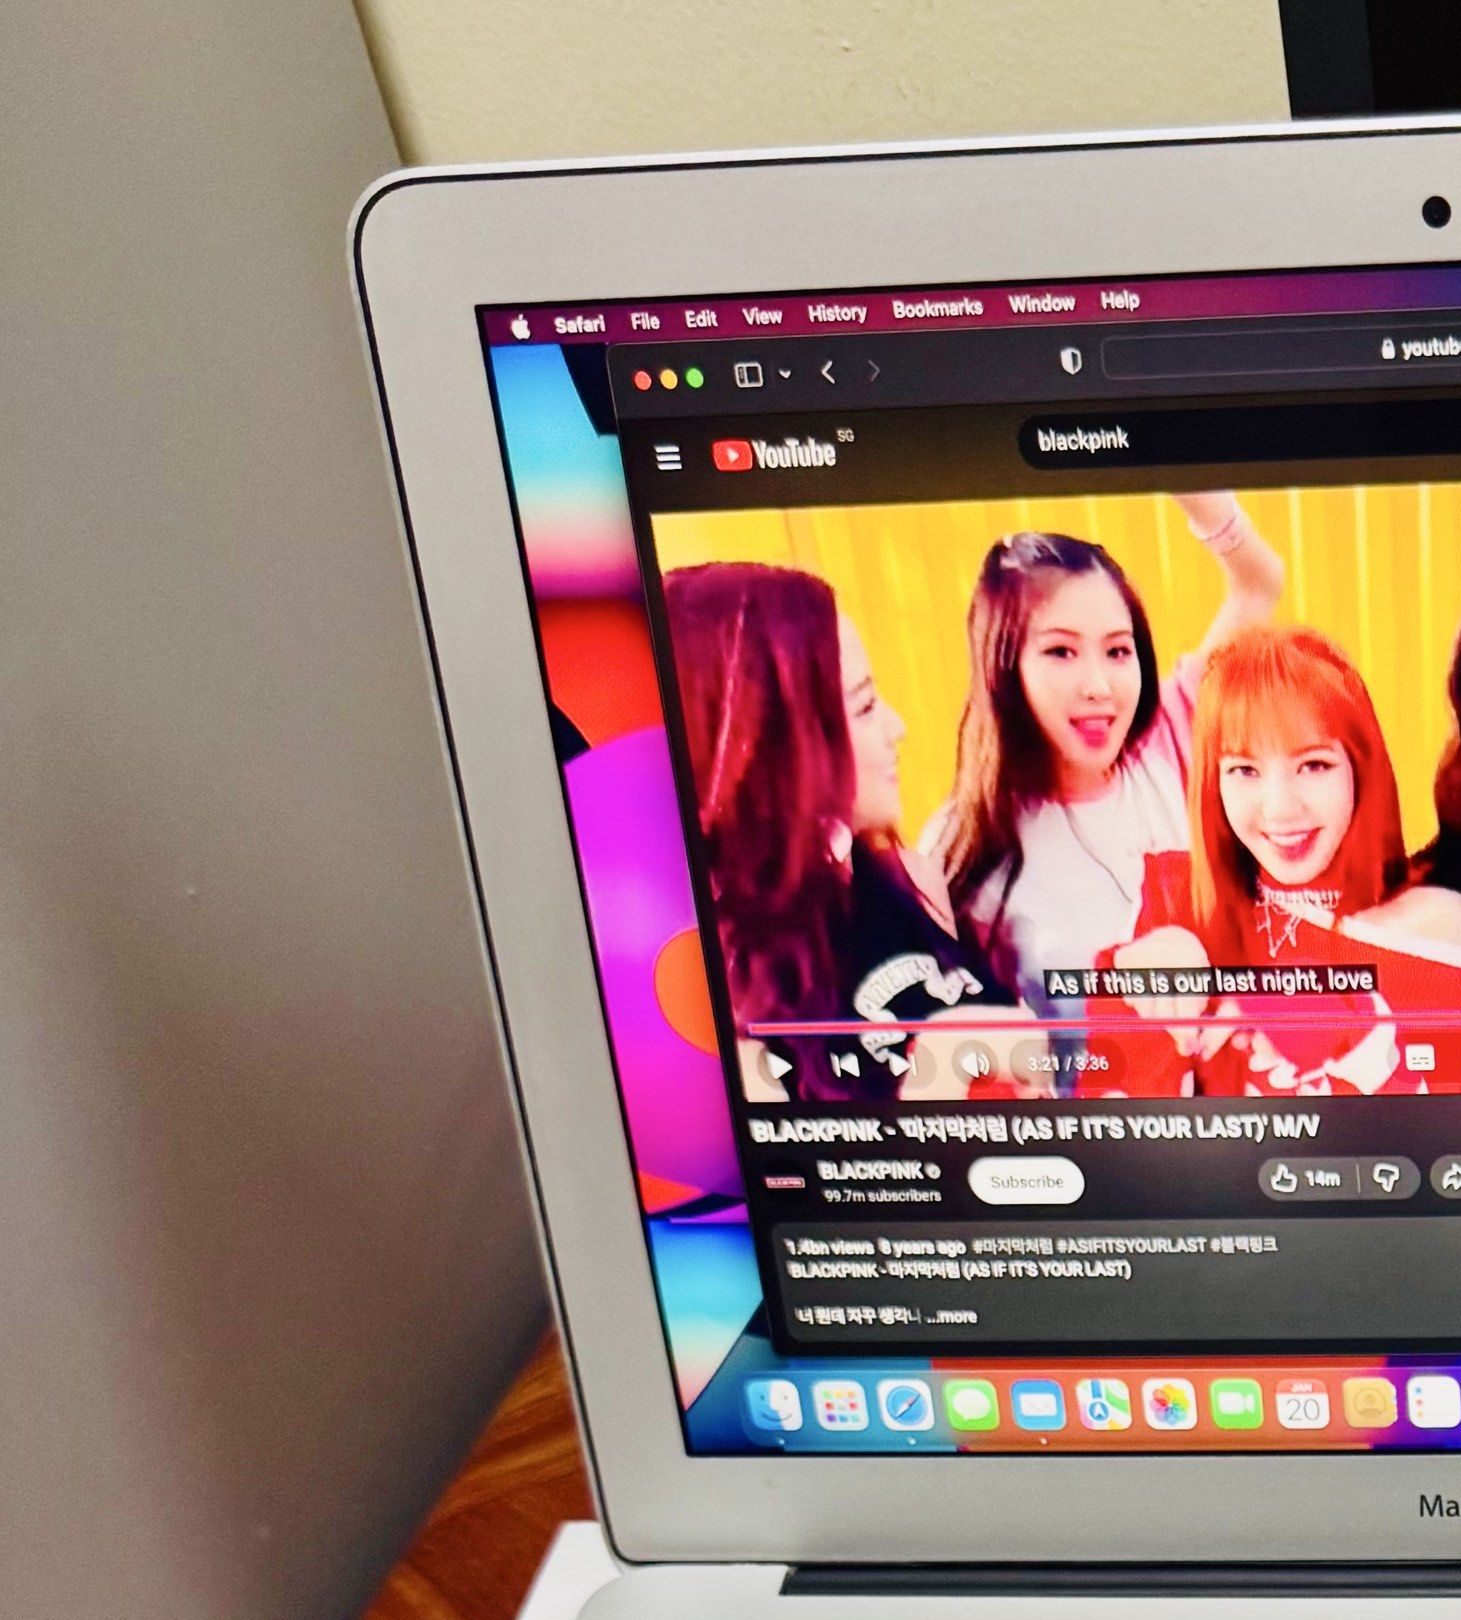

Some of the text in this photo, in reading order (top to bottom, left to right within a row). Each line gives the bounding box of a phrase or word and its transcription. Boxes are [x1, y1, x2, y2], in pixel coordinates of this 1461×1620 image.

[554, 290, 1140, 334] Safari File Edit View History Bookmarks Window Help
[753, 427, 854, 469] YouTube SG
[1037, 425, 1129, 454] blackpink
[1049, 968, 1373, 995] As if this is our last night, love
[1027, 1054, 1109, 1073] 3:21 3:36
[749, 1118, 883, 1143] BLACKPINK
[1012, 1116, 1053, 1145] (AS
[1056, 1117, 1079, 1139] IF
[1082, 1116, 1126, 1139] IT'S
[1128, 1116, 1192, 1139] YOUR
[1273, 1114, 1320, 1138] M/V
[817, 1160, 924, 1181] BLACKPINK
[1305, 1168, 1340, 1189] 14m
[991, 1174, 1064, 1190] Subscribe
[868, 1189, 941, 1202] subscribers
[1056, 1237, 1207, 1254] #ASIFITSYOURLAST
[1287, 1399, 1320, 1420] 20
